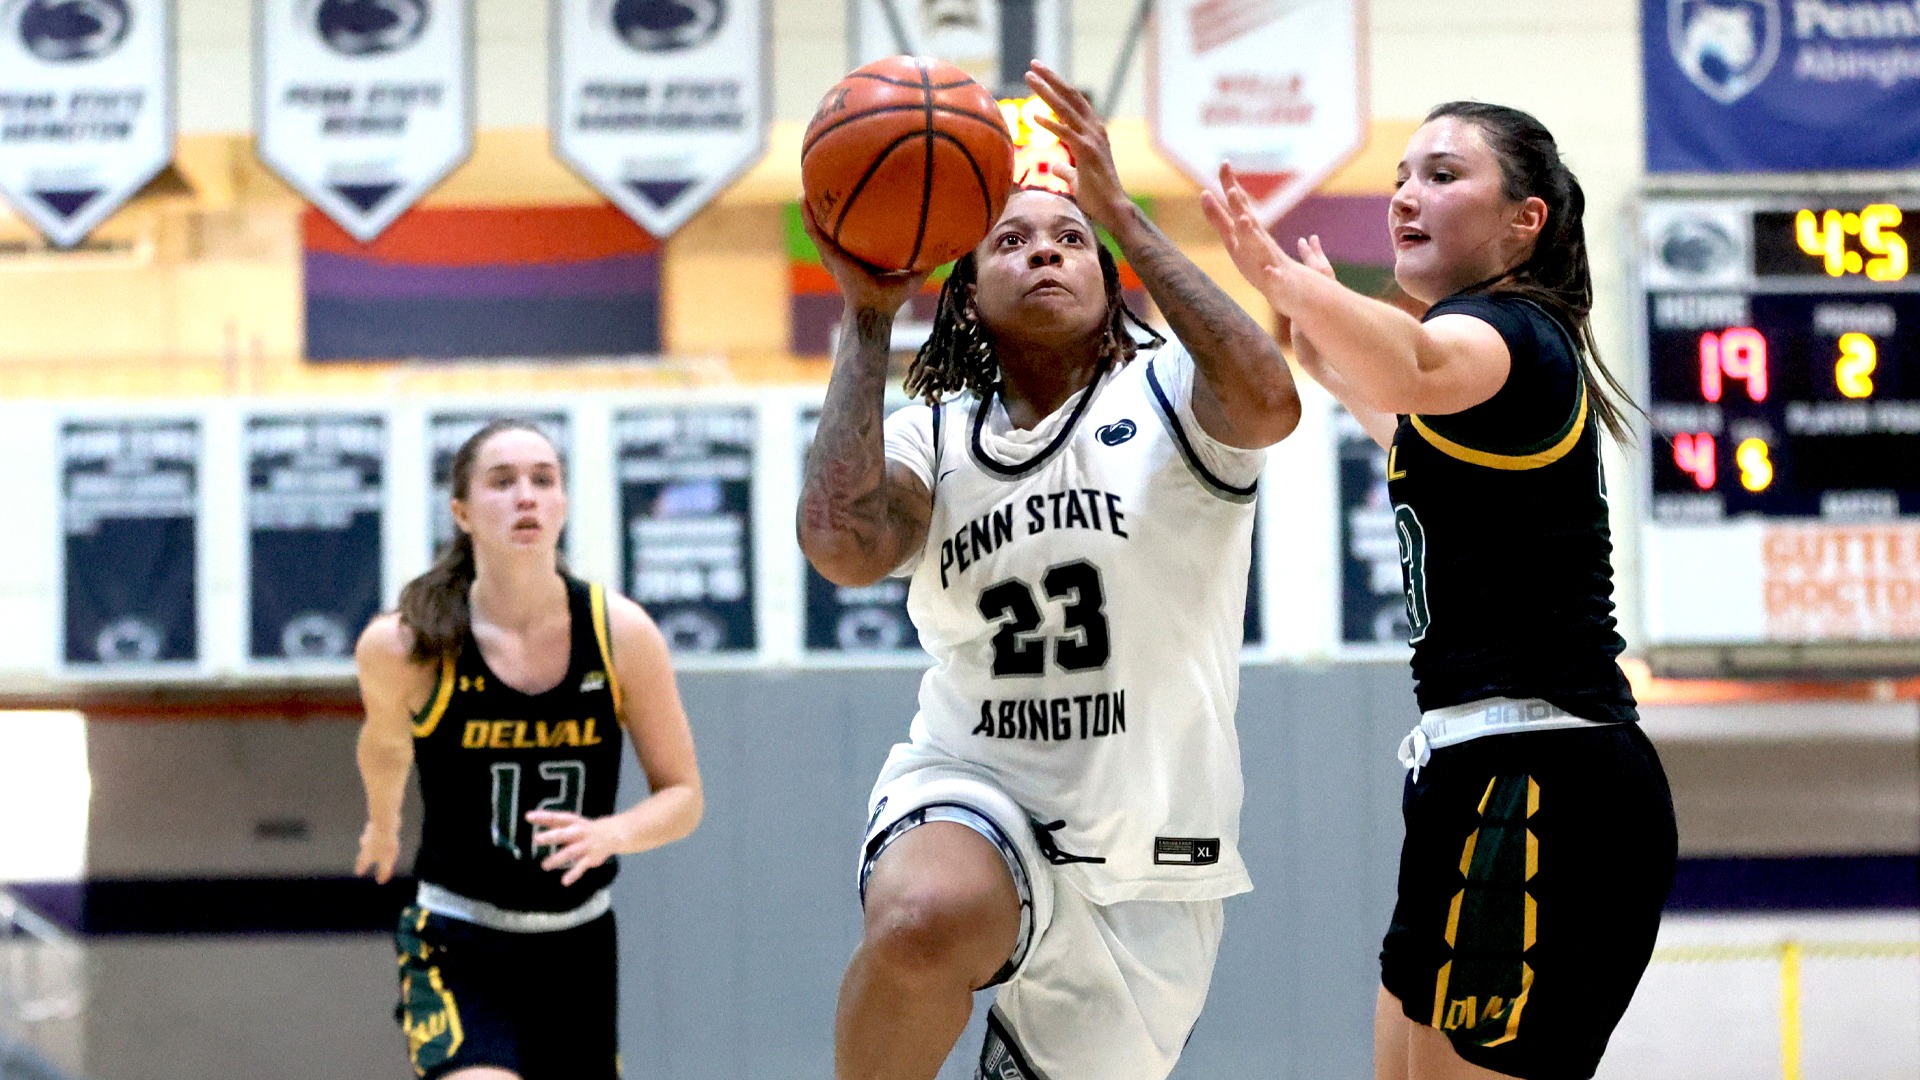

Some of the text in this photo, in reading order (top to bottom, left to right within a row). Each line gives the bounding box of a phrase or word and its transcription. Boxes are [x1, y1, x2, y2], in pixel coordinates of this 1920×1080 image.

[1793, 0, 1920, 38] Penn
[1699, 326, 1767, 403] 19
[1835, 332, 1877, 399] 2
[1673, 431, 1717, 490] 4
[940, 488, 1130, 590] PENN STATE
[1763, 531, 1920, 570] GUTTE
[976, 557, 1112, 680] 23
[1763, 575, 1920, 615] DOCTO
[461, 717, 603, 749] DELVAL
[972, 689, 1127, 742] ABINGTON
[1197, 846, 1213, 858] XL
